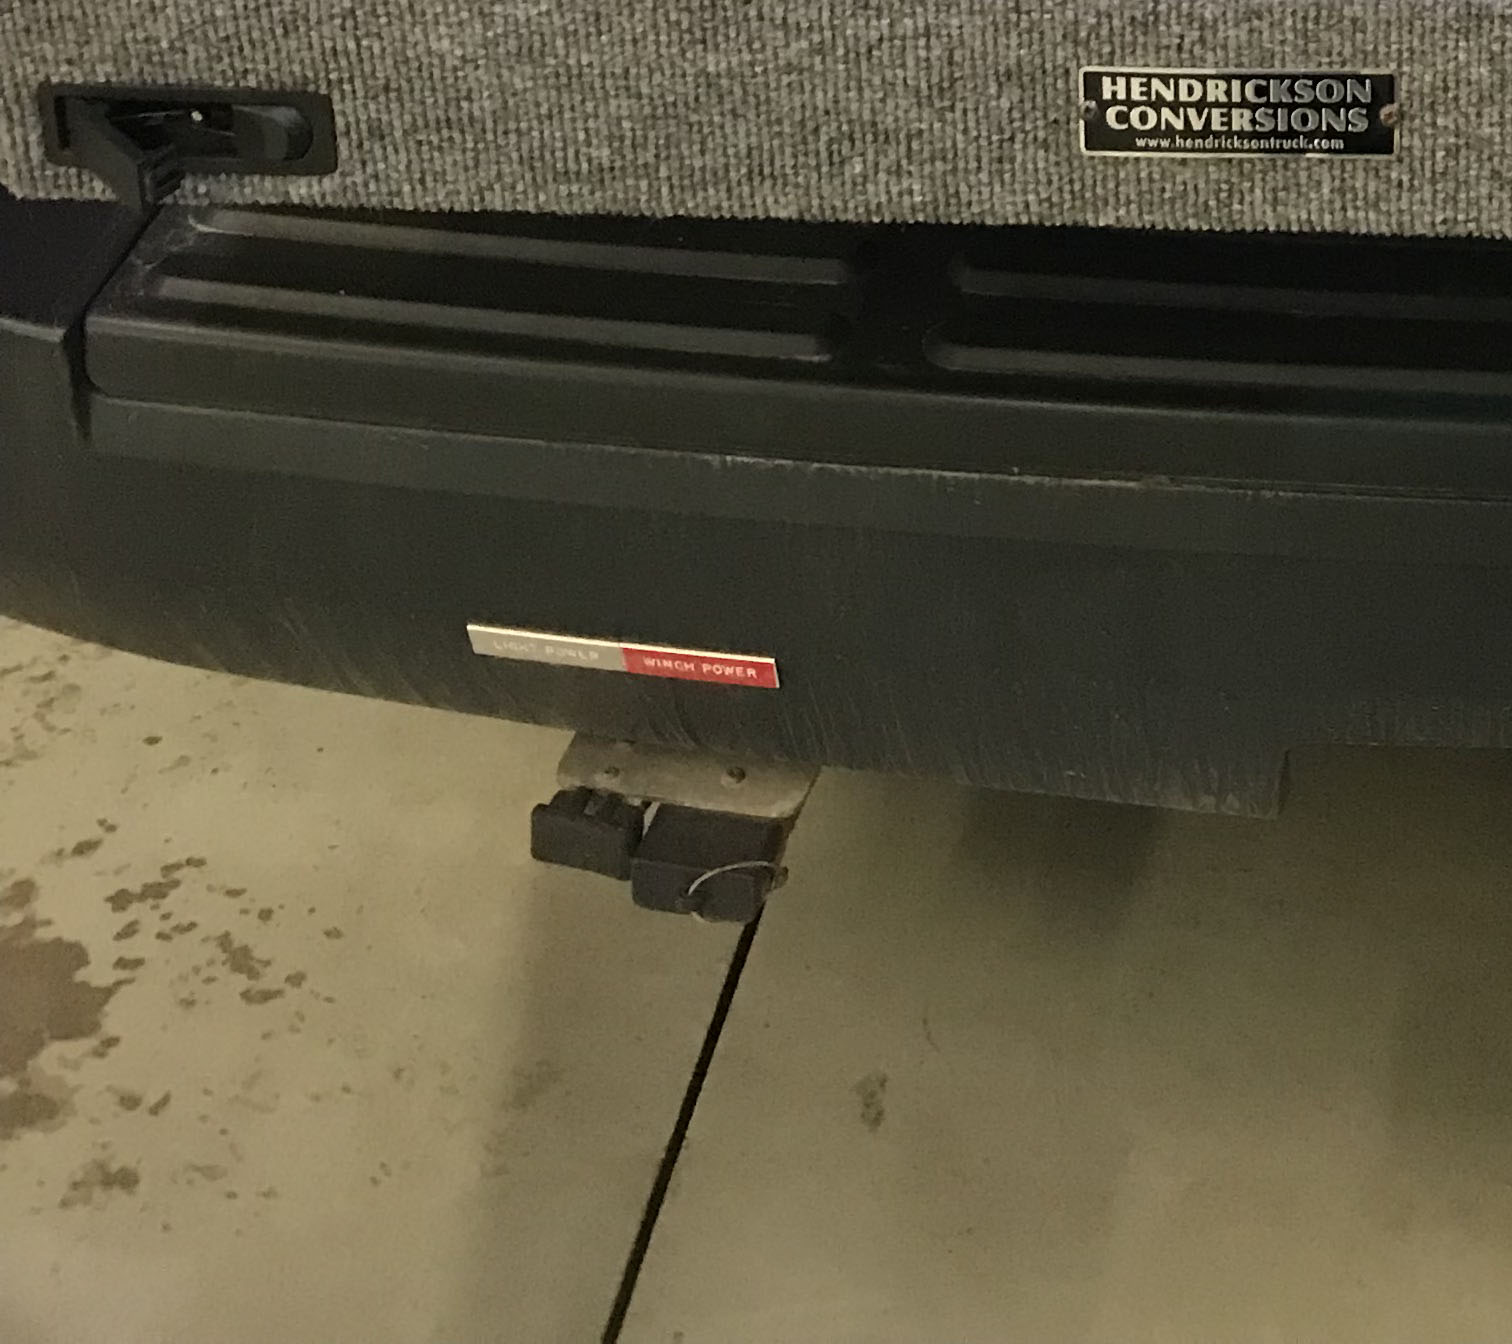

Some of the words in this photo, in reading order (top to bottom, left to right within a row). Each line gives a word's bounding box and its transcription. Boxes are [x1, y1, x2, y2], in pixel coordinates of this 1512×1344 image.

[1101, 75, 1373, 104] HENDRICKSON
[1105, 105, 1370, 133] CONVERSIONS
[1135, 134, 1346, 152] www.hendricksontruck.com
[642, 655, 699, 674] WINCH
[702, 661, 761, 681] POWER
